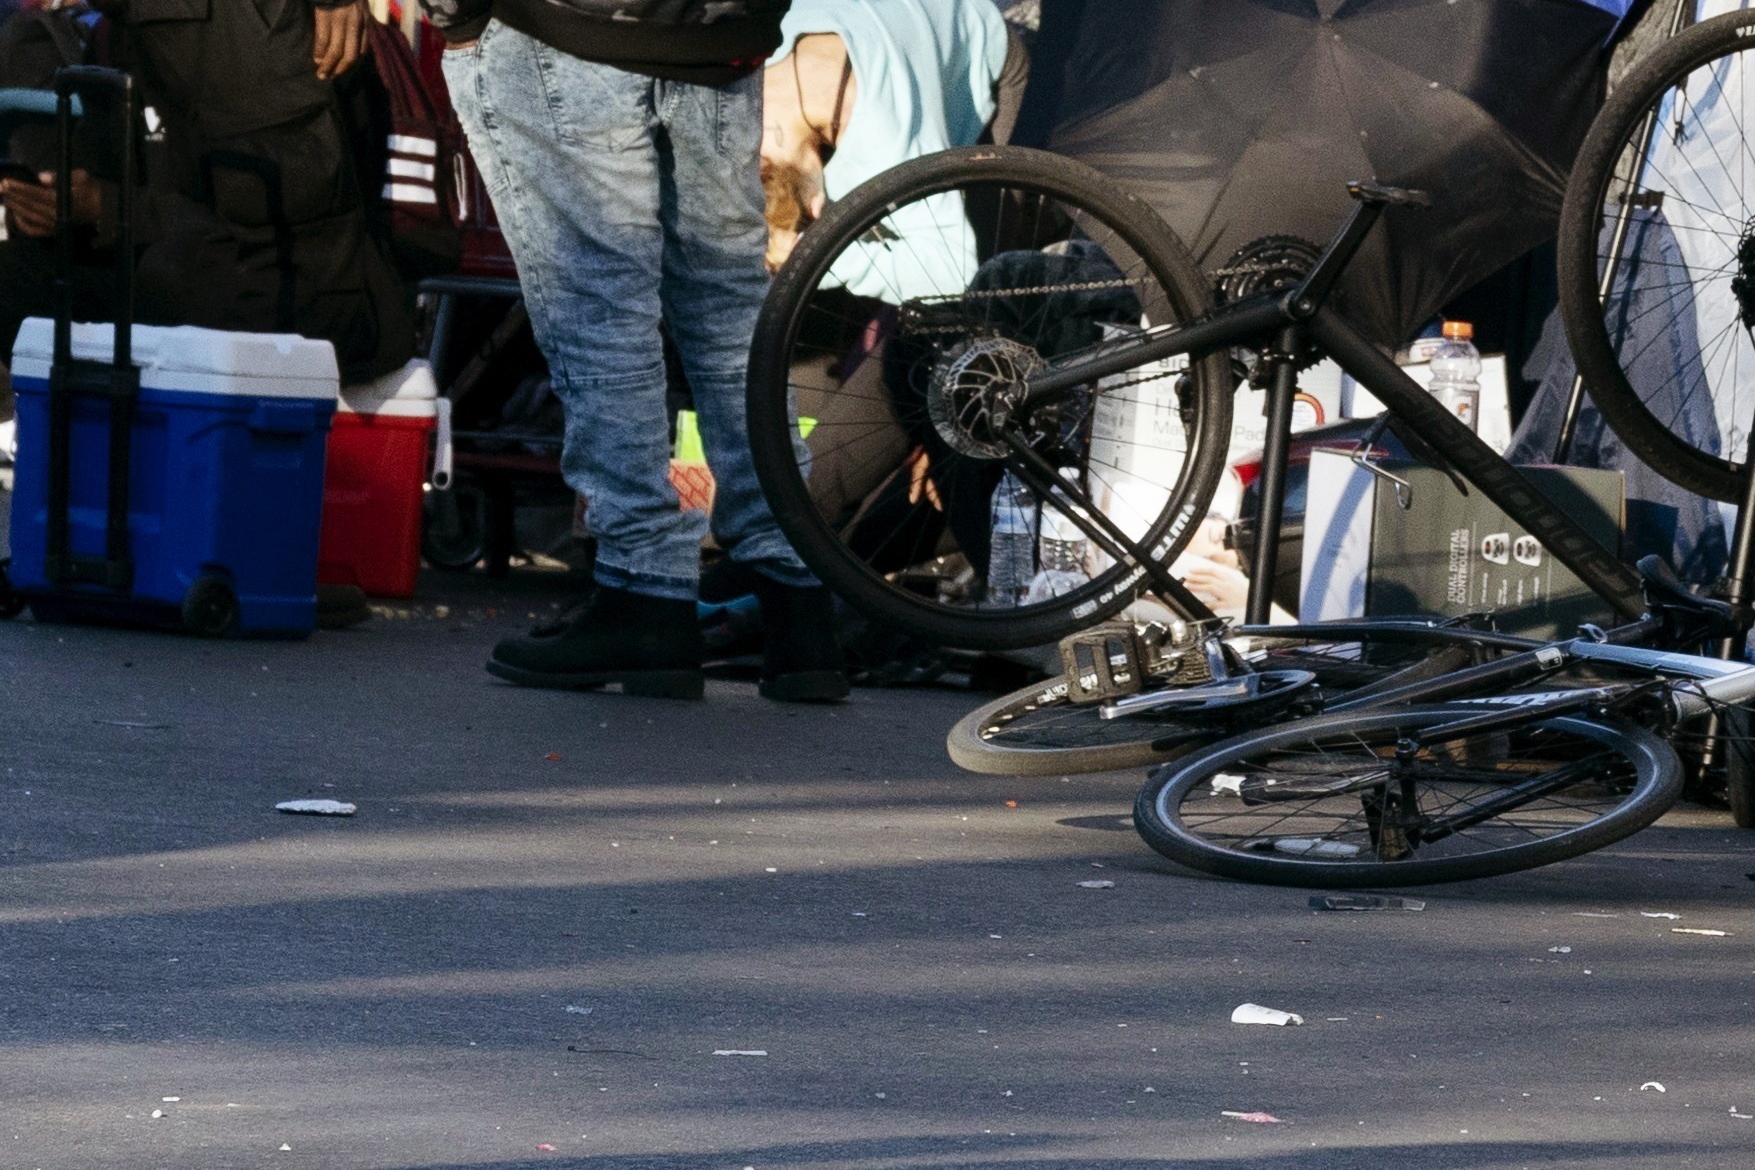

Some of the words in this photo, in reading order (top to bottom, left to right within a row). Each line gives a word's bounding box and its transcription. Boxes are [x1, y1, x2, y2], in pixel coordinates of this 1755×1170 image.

[1449, 529, 1460, 572] DIGITAL
[1456, 528, 1469, 604] CONTROLLERS
[1447, 575, 1457, 602] DUAL
